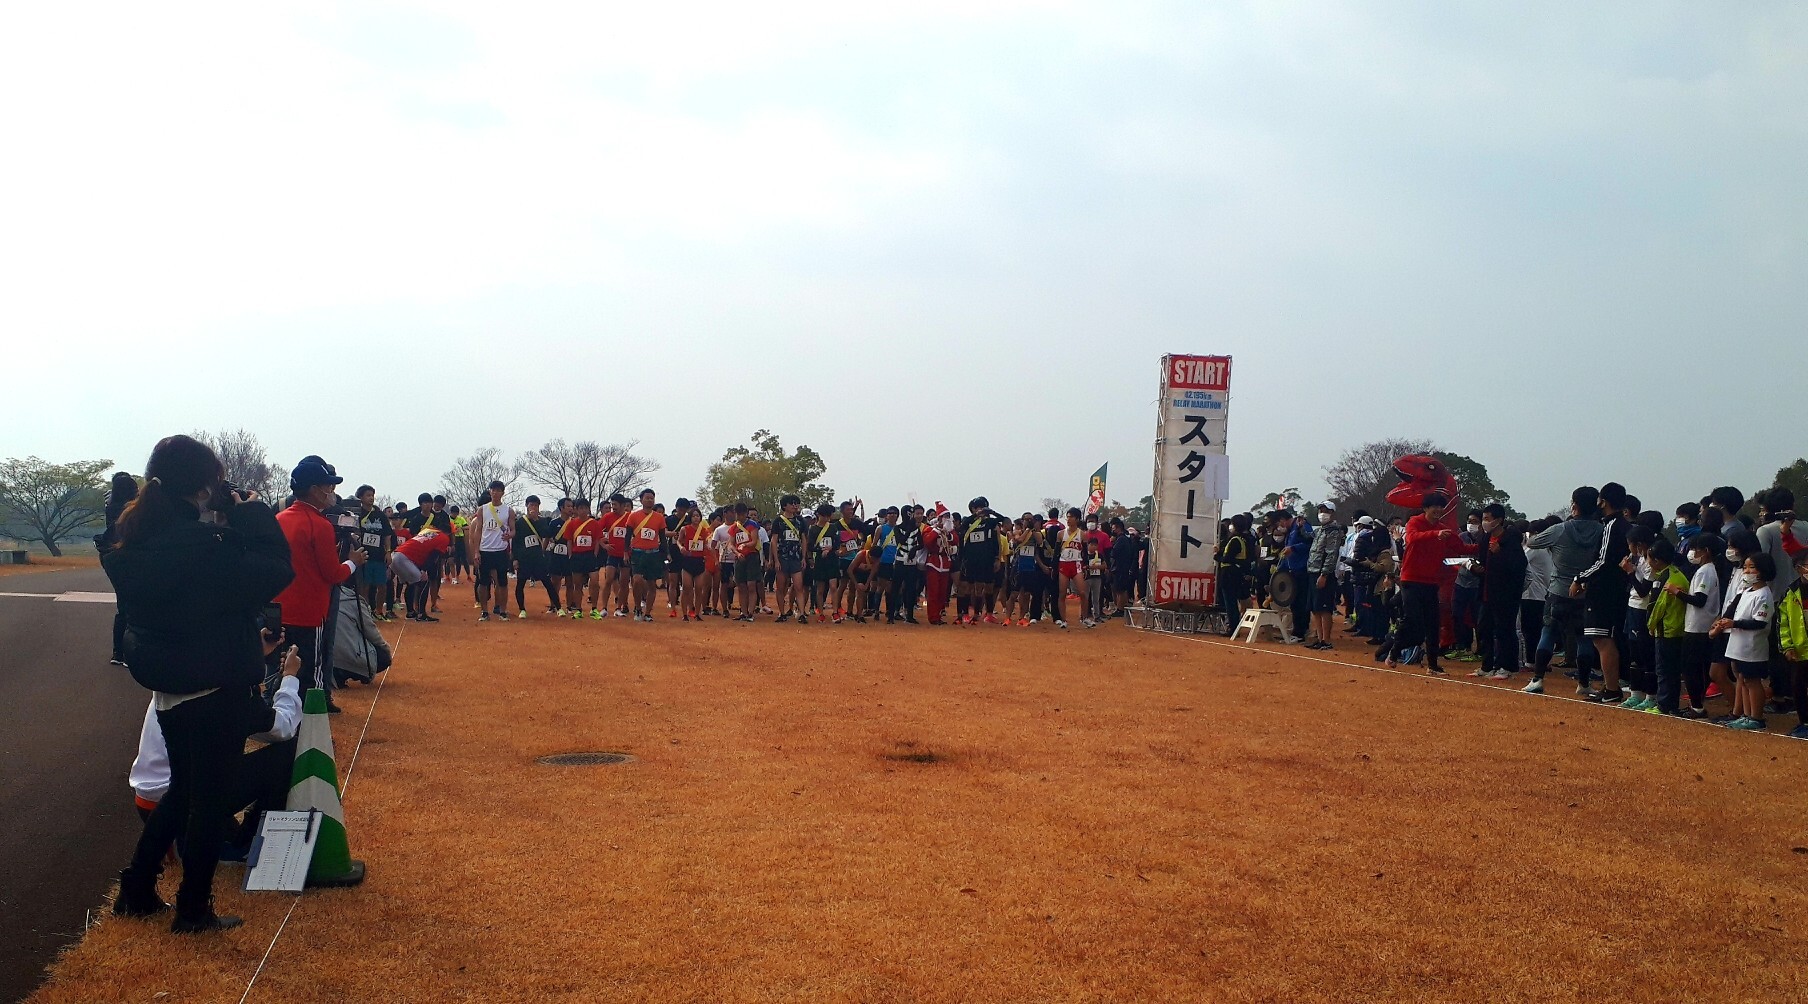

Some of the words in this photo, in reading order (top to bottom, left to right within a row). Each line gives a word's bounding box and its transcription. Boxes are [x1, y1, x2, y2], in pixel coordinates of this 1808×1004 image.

[1174, 359, 1226, 386] START
[1173, 399, 1190, 408] RELAY
[1190, 400, 1222, 410] MARATHON
[1177, 415, 1210, 559] スタート
[1160, 576, 1211, 601] START
